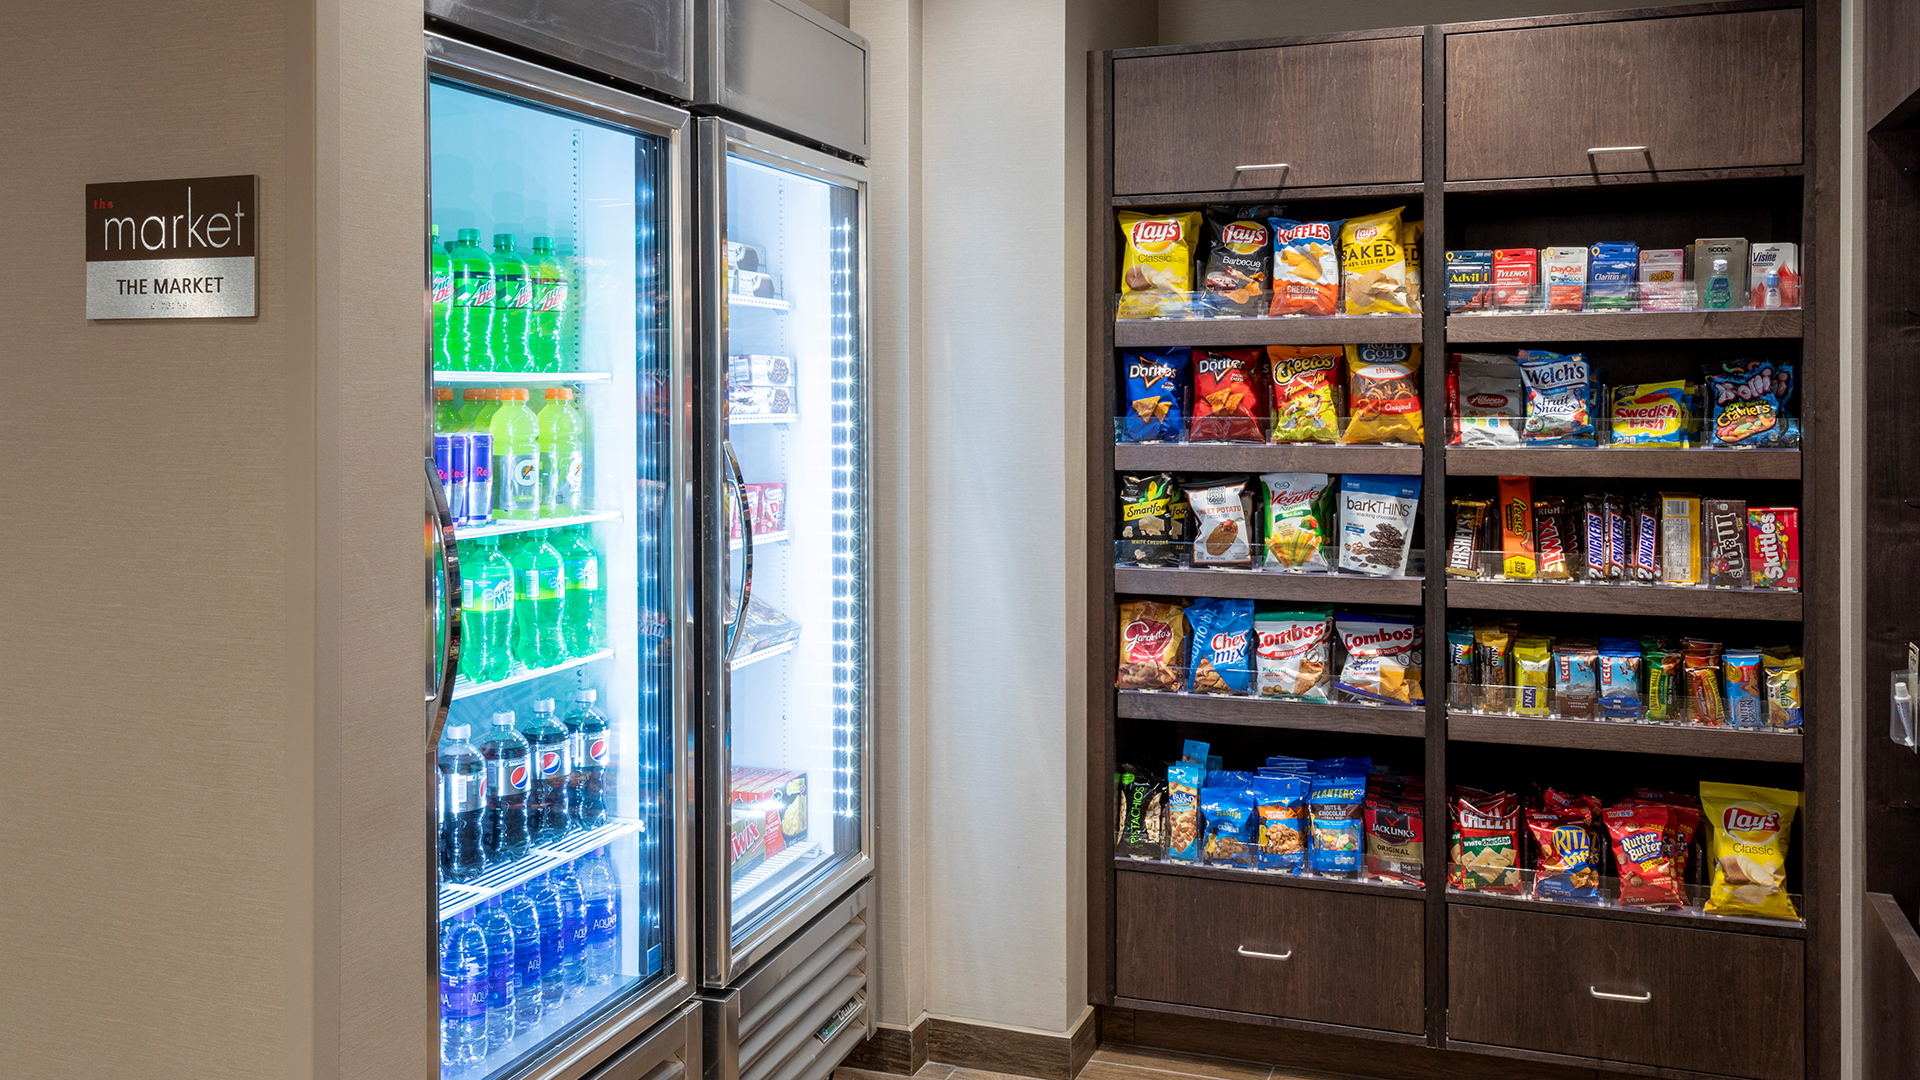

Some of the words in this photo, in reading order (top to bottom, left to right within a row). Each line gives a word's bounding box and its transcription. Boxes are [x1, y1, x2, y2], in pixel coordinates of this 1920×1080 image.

[94, 198, 114, 209] the
[104, 186, 244, 250] market
[1136, 220, 1178, 243] Lay's
[1226, 224, 1265, 245] Lay's
[1277, 223, 1331, 245] RUFFLES
[1355, 226, 1377, 239] Lay's
[1138, 254, 1172, 263] Classic
[1342, 244, 1396, 262] BAKED
[1708, 246, 1732, 254] scope
[1752, 252, 1777, 262] Visine
[1222, 256, 1262, 268] Barbecue
[1550, 266, 1582, 274] DayQuil
[1450, 272, 1480, 283] Advil
[1496, 270, 1529, 278] TYLENOL
[1594, 272, 1620, 281] Claritin
[116, 278, 148, 295] THE
[154, 276, 224, 294] MARKET
[1286, 285, 1319, 294] CHEDDAR
[1362, 350, 1407, 362] GOLD
[1129, 362, 1178, 379] Doritos
[1275, 355, 1334, 384] Cheetos
[1524, 363, 1586, 385] Welch's
[1384, 402, 1412, 412] Original
[1534, 402, 1576, 414] Snacks
[1542, 395, 1571, 406] Fruit
[1614, 403, 1678, 422] Swedish
[1716, 404, 1771, 427] Crawlers
[1628, 417, 1666, 431] Fish
[1271, 488, 1320, 506] Veggie
[1346, 496, 1411, 517] barkTHINS
[1216, 505, 1242, 514] POTATO
[1512, 497, 1528, 537] Reese's
[1588, 514, 1604, 568] SNICKERS
[1638, 513, 1656, 569] SNICKERS
[1758, 512, 1784, 579] Skittles
[1124, 620, 1172, 653] Gardetto's
[1212, 630, 1249, 651] Chex
[1257, 623, 1326, 649] Combos
[1345, 628, 1413, 649] Combos
[1215, 643, 1246, 664] mix
[1455, 644, 1464, 664] KIND
[1602, 658, 1610, 678] CLIF
[1780, 679, 1790, 706] belVita
[1312, 789, 1355, 800] PLANTERS
[1365, 800, 1378, 808] 100
[1130, 786, 1145, 844] PISTACHIOS
[1216, 810, 1242, 819] PLANTERS
[1728, 808, 1779, 832] Lay's
[1372, 822, 1390, 834] JACK
[1390, 828, 1416, 838] LINK'S
[1376, 844, 1410, 856] ORIGINAL
[1554, 828, 1589, 854] RITZ
[1621, 832, 1658, 852] Nutter
[1732, 842, 1774, 856] Classic
[1628, 840, 1662, 862] Butter
